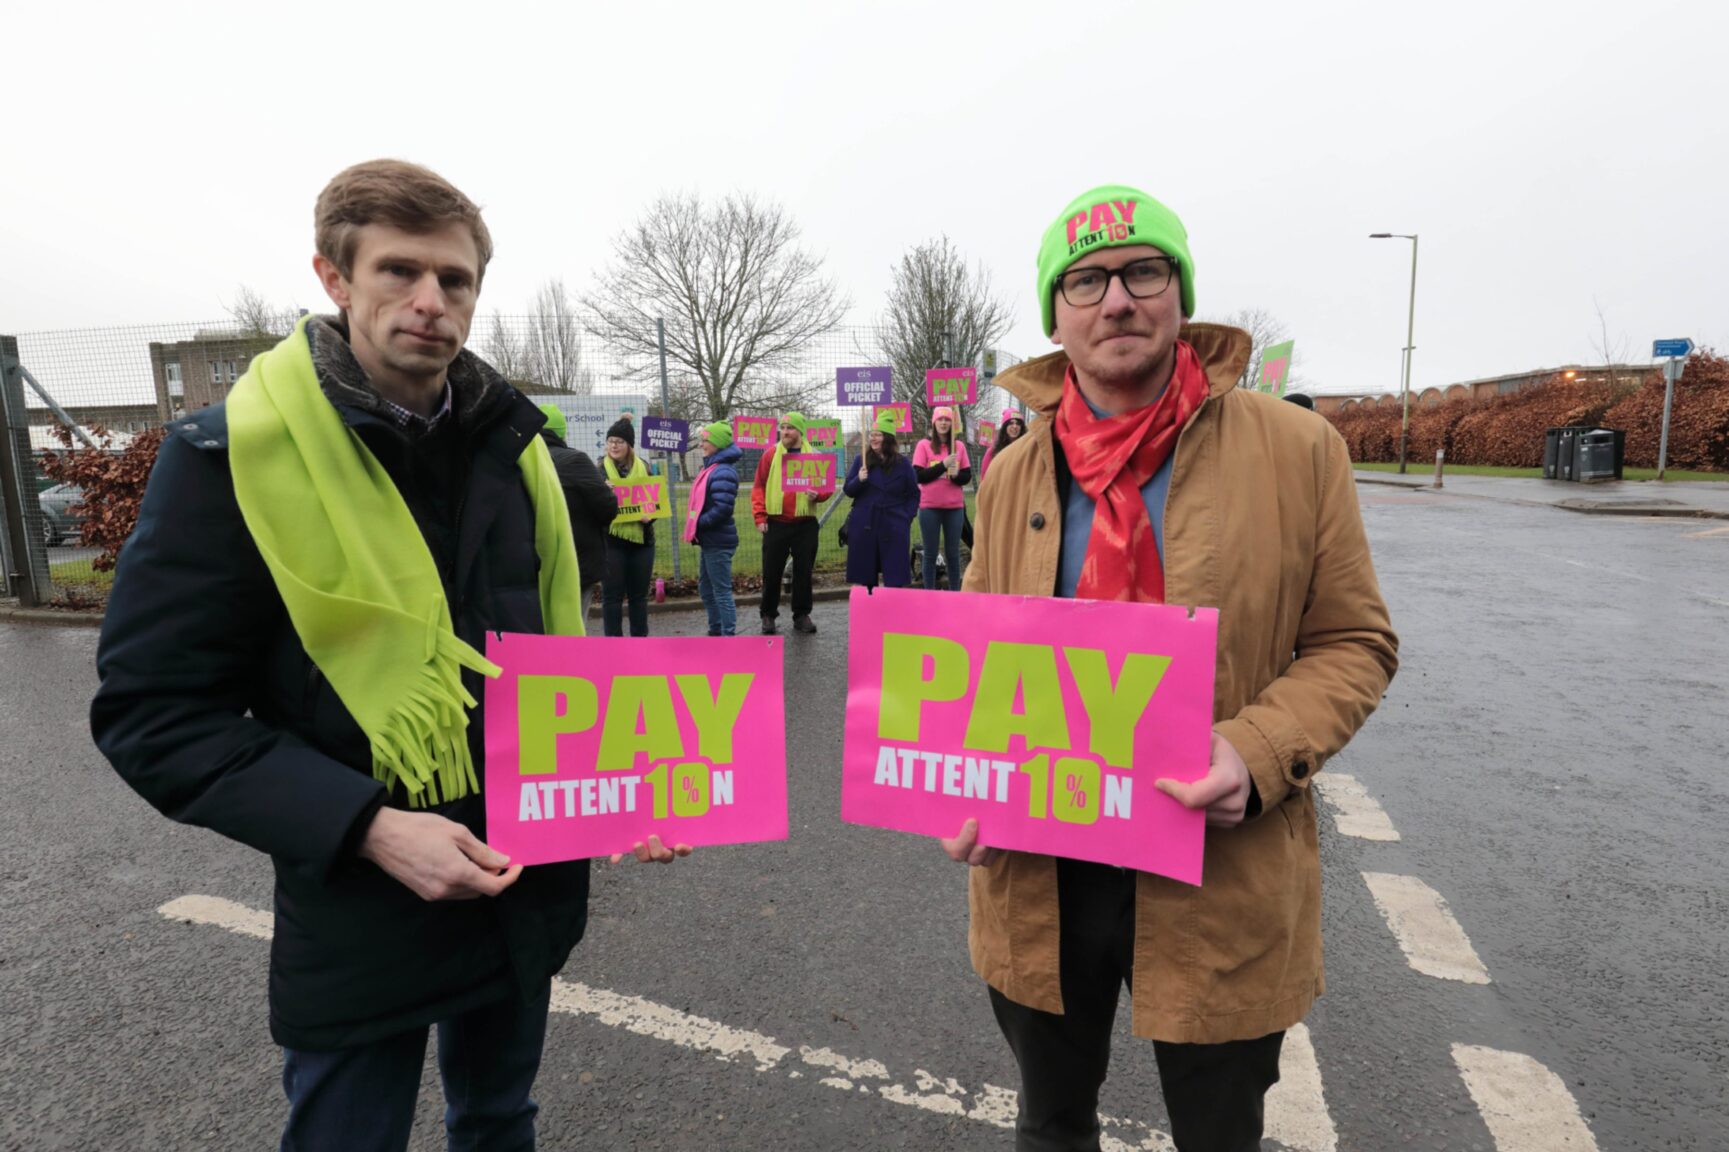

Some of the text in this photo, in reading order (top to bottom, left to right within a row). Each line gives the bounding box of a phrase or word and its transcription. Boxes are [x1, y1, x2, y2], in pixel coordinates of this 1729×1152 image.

[1066, 199, 1137, 246] PAY
[844, 382, 885, 392] OFFICIAL
[933, 378, 970, 395] PAY
[848, 392, 882, 402] PICKET
[574, 413, 605, 422] School
[647, 429, 683, 440] OFFICIAL
[738, 422, 772, 436] PAY
[806, 427, 837, 441] PAY
[650, 438, 679, 449] PICKET
[787, 460, 830, 477] PAY
[613, 483, 660, 506] PAY
[877, 632, 1173, 770] PAY
[518, 672, 755, 775] PAY
